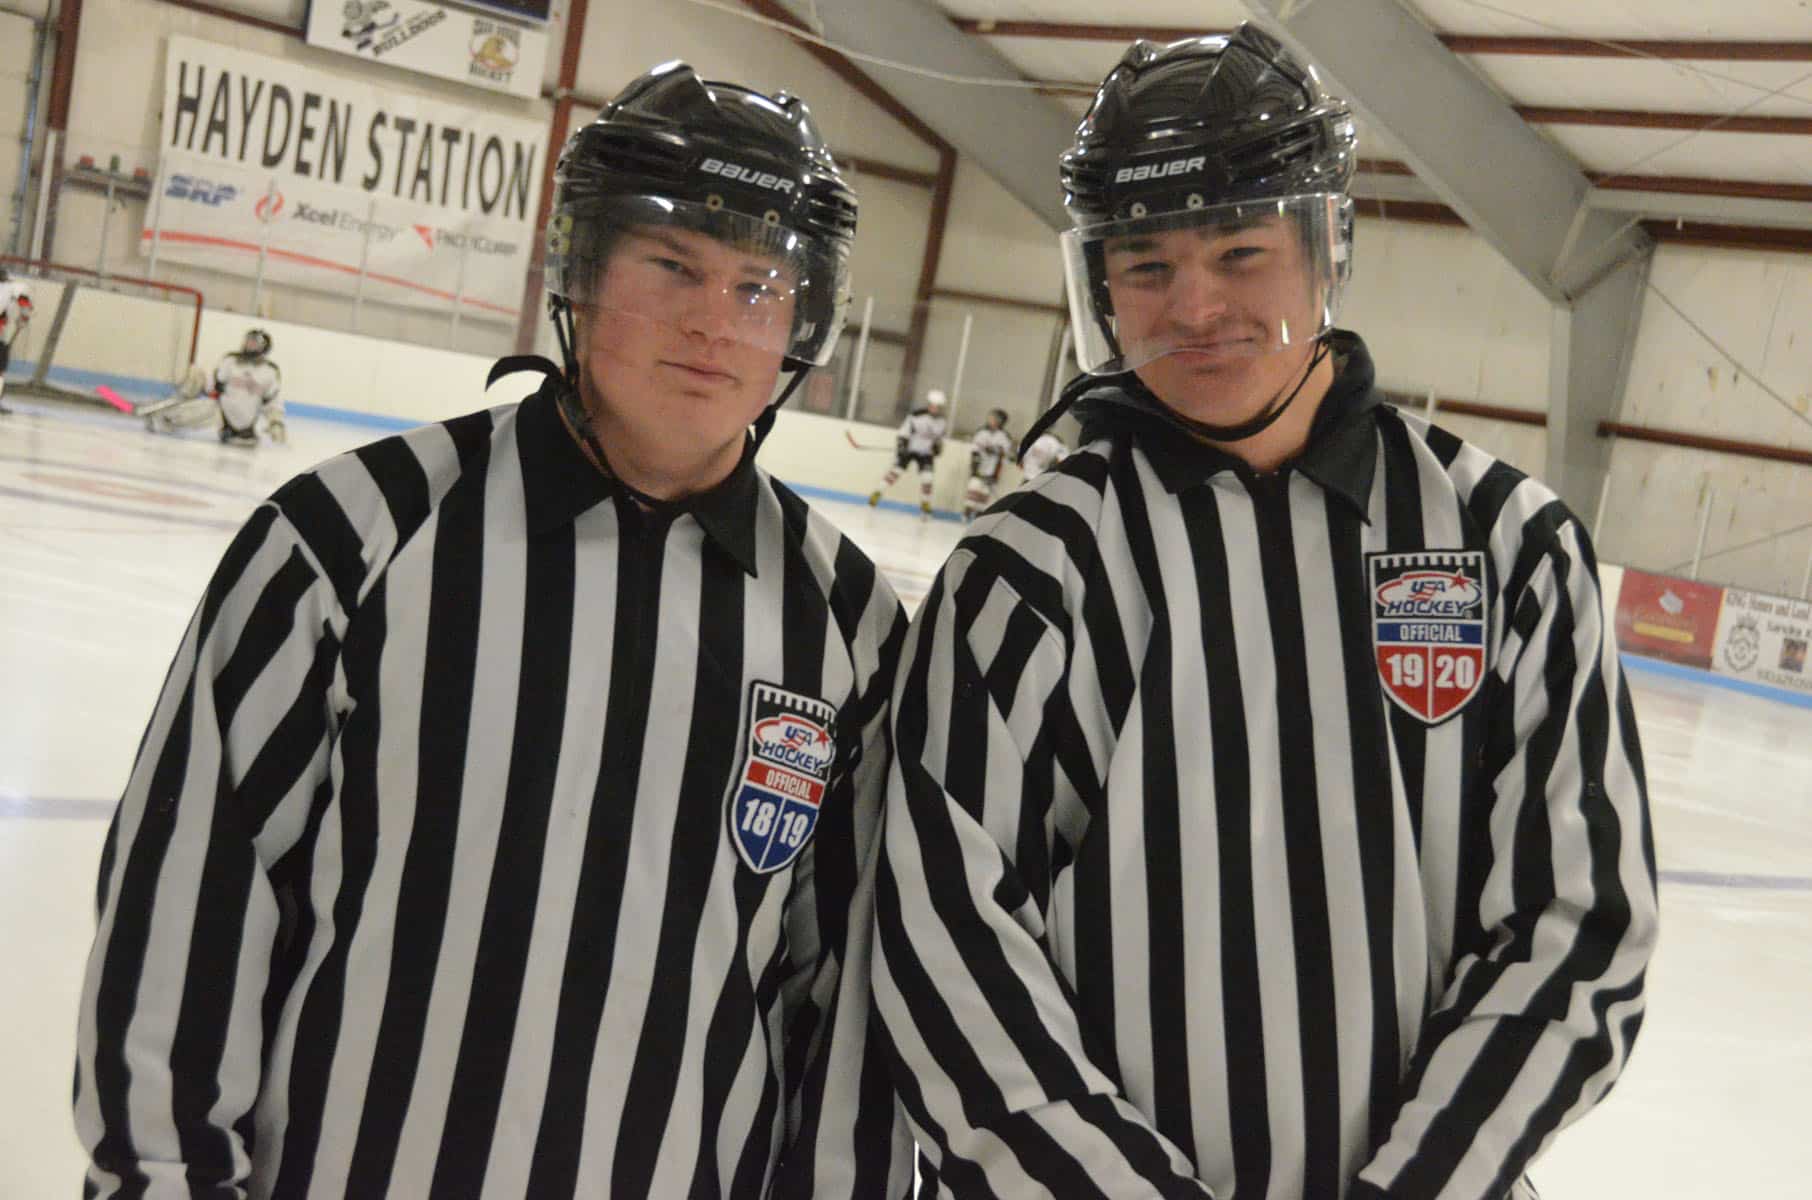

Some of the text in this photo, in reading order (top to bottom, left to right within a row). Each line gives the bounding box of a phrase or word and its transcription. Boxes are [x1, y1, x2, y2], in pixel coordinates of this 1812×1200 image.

[171, 61, 536, 221] HAYDEN STATION
[700, 158, 795, 194] BAUER
[1115, 156, 1206, 183] BAUER
[1411, 580, 1446, 593] USA
[1387, 600, 1468, 614] HOCKEY
[1399, 623, 1463, 642] OFFICIAL
[1386, 653, 1476, 690] 19 20
[784, 725, 813, 747] USA
[761, 740, 823, 771] HOCKEY
[766, 769, 812, 800] OFFICIAL
[742, 798, 809, 849] 18 19
